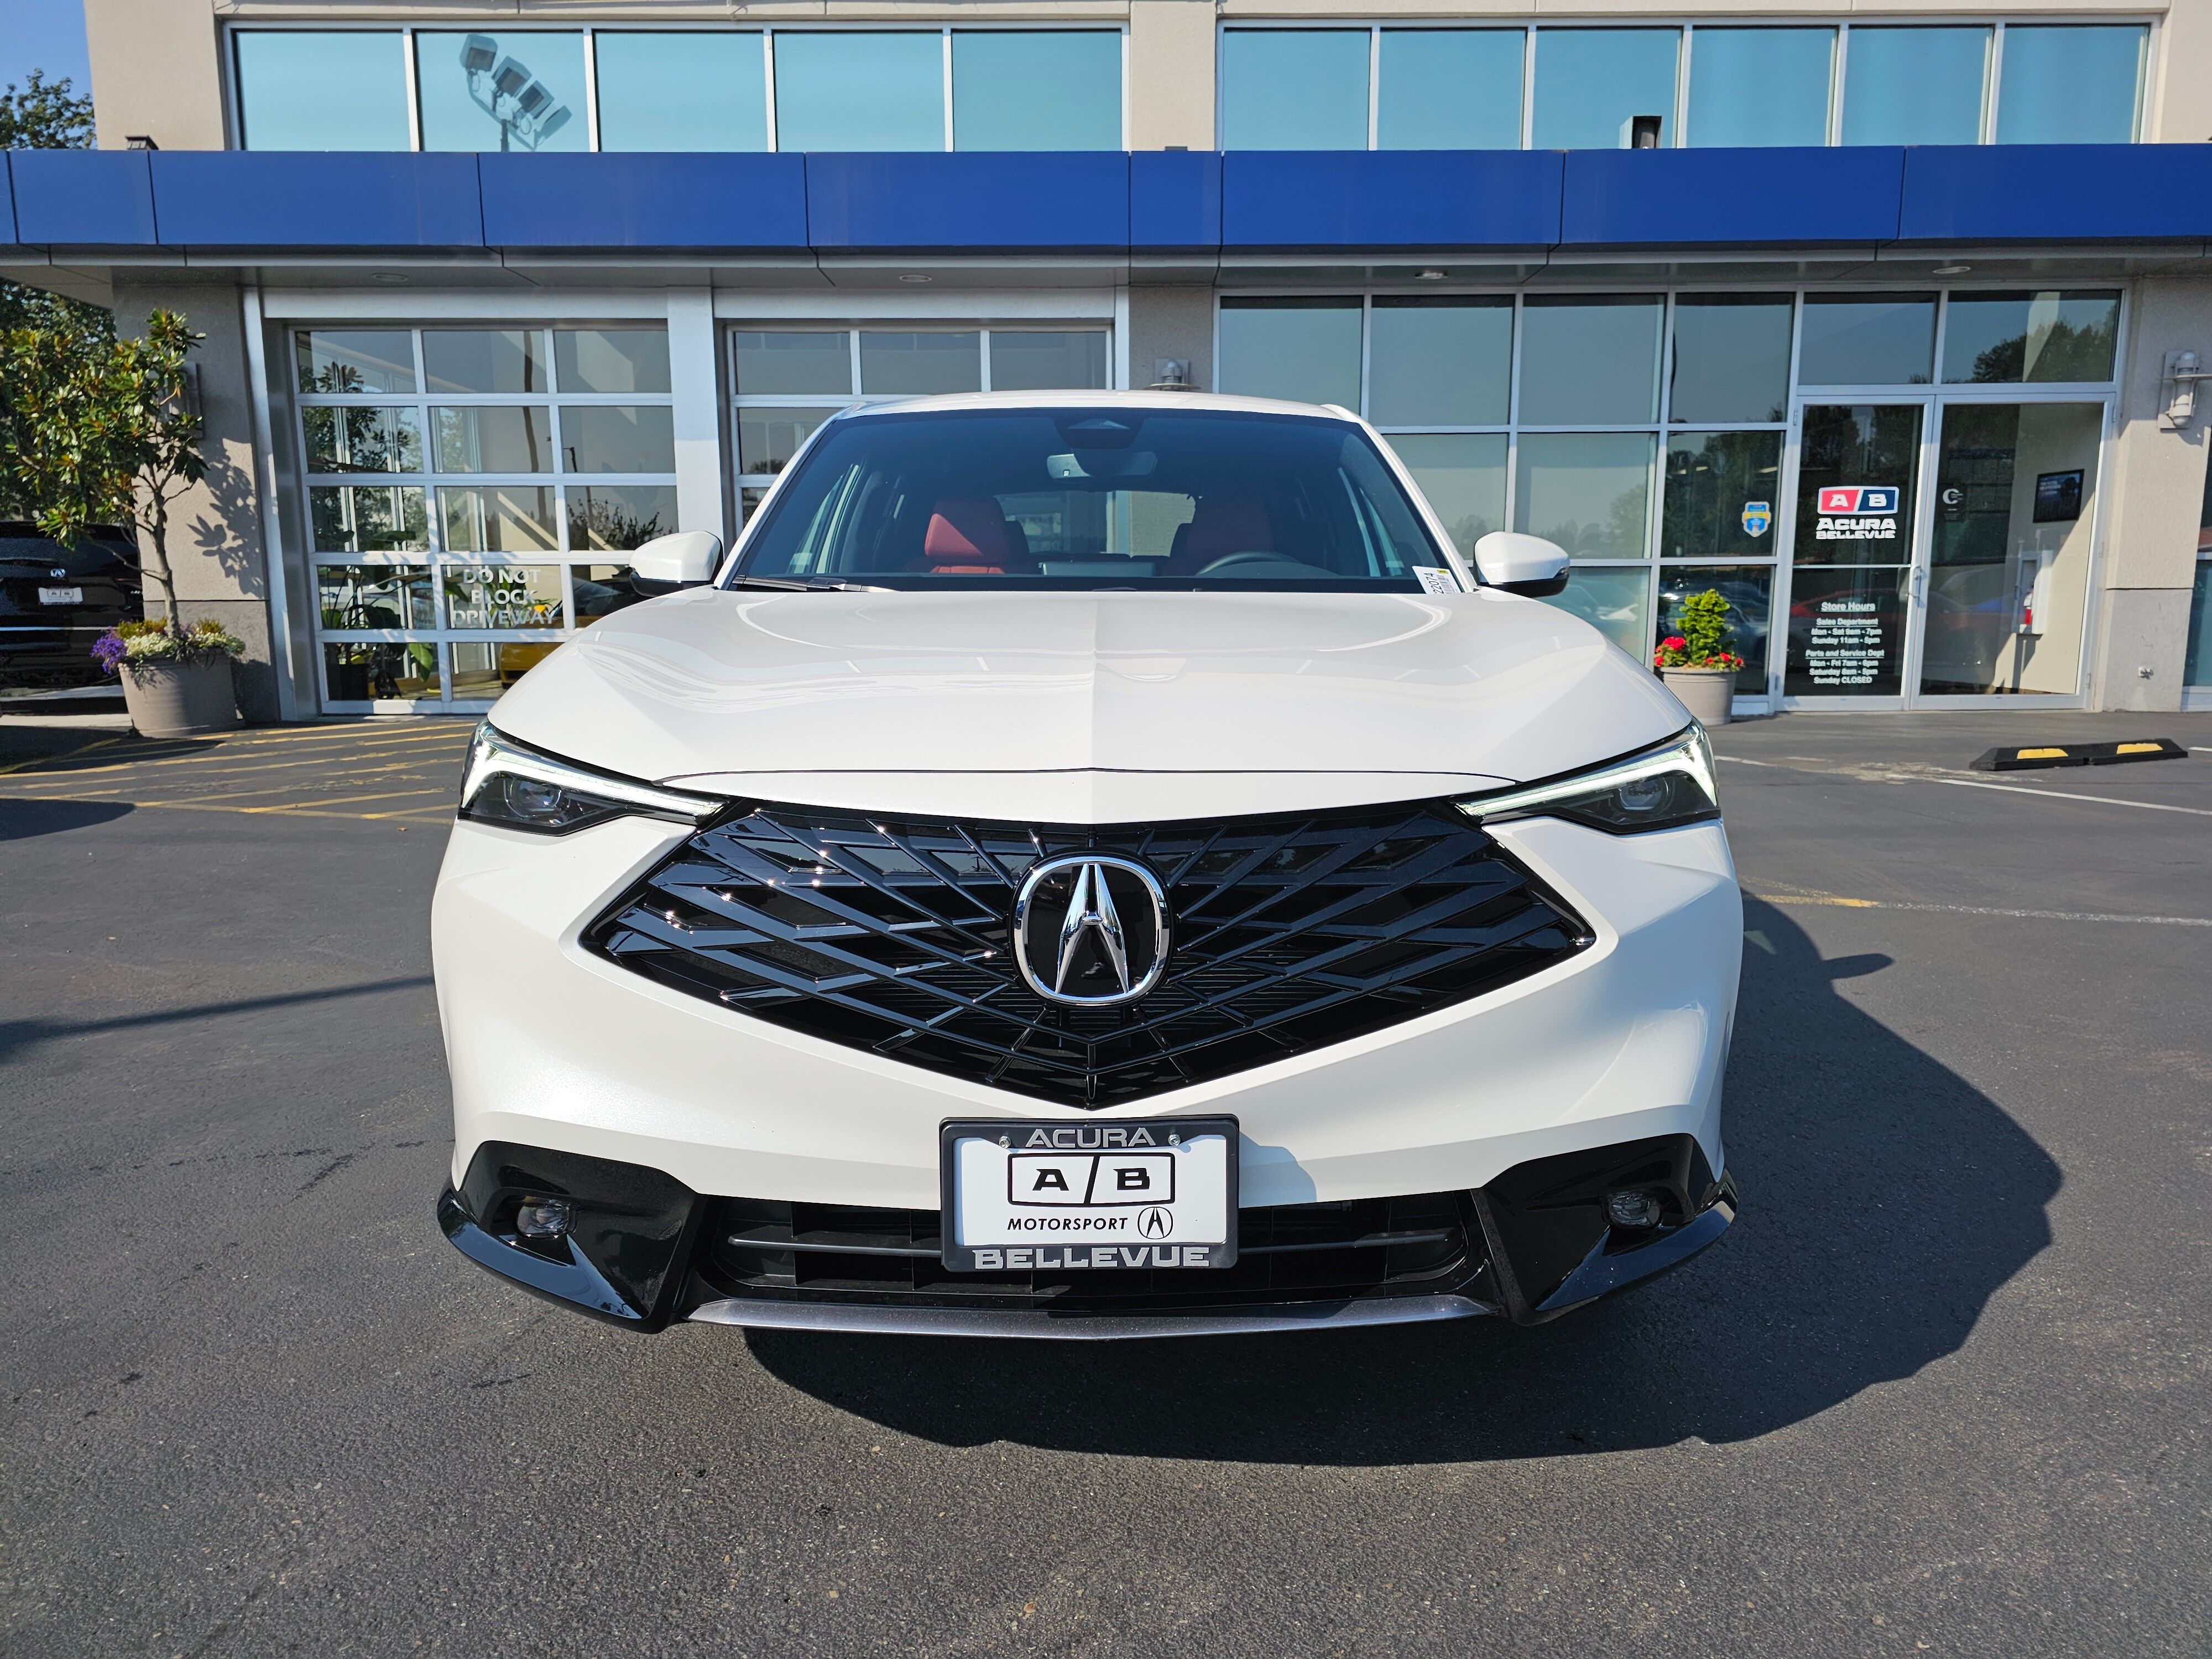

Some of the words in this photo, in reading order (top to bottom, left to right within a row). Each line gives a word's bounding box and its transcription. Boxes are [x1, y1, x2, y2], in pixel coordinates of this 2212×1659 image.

[1829, 493, 1849, 507] A
[1867, 493, 1887, 507] B
[1816, 518, 1897, 530] ACURA
[1815, 530, 1896, 540] BELLEVUE
[463, 568, 494, 583] DO
[499, 568, 541, 583] NOT
[471, 589, 536, 605] BLOCK
[1821, 602, 1846, 611] Store
[1848, 601, 1876, 611] Hours
[454, 610, 555, 625] DRIVEWAY
[1837, 618, 1879, 627] Department
[1812, 637, 1839, 645] Sunday
[1867, 649, 1885, 658] Dept
[1809, 667, 1841, 676] Saturday
[1814, 676, 1840, 685] Sunday
[1841, 676, 1872, 684] CLOSED
[1025, 1128, 1156, 1149] ACURA
[1032, 1168, 1070, 1191] A
[1113, 1167, 1150, 1191] B
[1007, 1217, 1129, 1231] MOTORSPORT
[972, 1246, 1211, 1270] BELLEVUE
